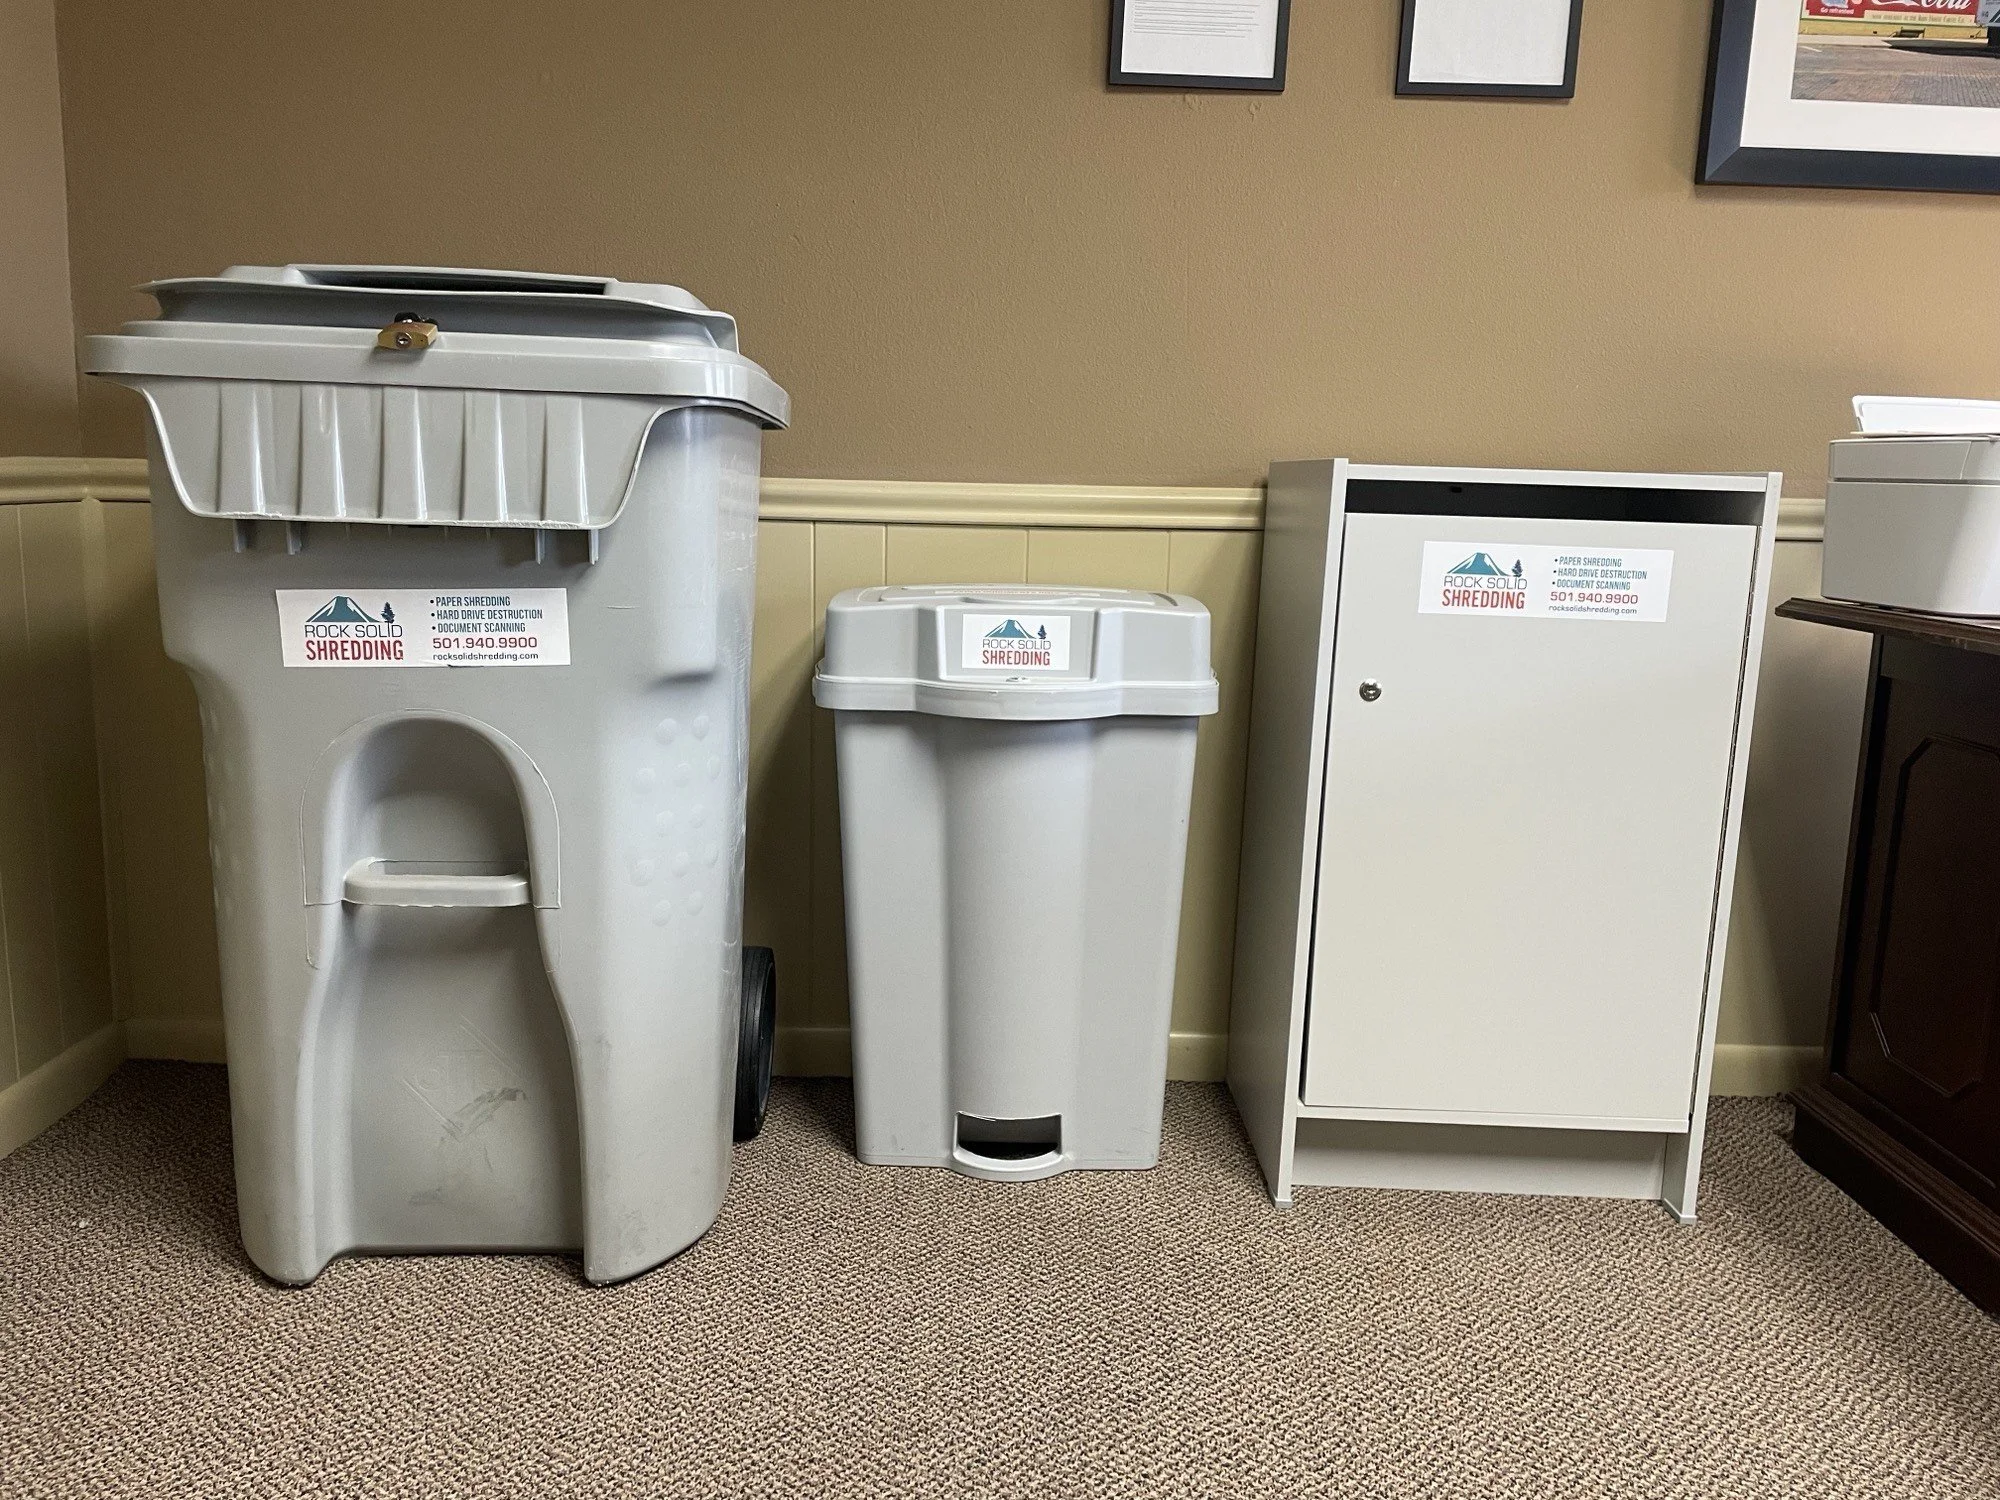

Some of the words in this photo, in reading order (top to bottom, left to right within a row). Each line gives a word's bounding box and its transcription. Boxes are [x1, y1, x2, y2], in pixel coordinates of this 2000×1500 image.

[1559, 556, 1582, 566] PAPER
[1583, 557, 1622, 568] SHREDDING
[1558, 568, 1577, 577] HARD
[1578, 568, 1599, 579] DRIVE
[1600, 569, 1648, 580] DESTRUCTION
[1443, 575, 1483, 589] ROCK
[1486, 577, 1528, 590] SOLID
[1556, 579, 1594, 589] DOCUMENT
[1595, 580, 1631, 591] SCANNING
[435, 596, 462, 607] PAPER
[463, 596, 511, 607] SHREDDING
[1442, 588, 1525, 609] SHREDDING
[1550, 591, 1639, 604] 501.940.9900
[436, 609, 460, 620] HARD
[461, 609, 486, 620] DRIVE
[487, 609, 543, 619] DESTRUCTION
[1548, 605, 1638, 616] rocksolidshredding.com
[304, 624, 351, 638] ROCK
[354, 624, 403, 638] SOLID
[437, 622, 482, 633] DOCUMENT
[484, 622, 526, 633] SCANNING
[432, 637, 538, 649] 501.940.9900
[982, 638, 1015, 649] ROCK
[1017, 639, 1052, 650] SOLID
[306, 639, 404, 661] SHREDDING
[432, 652, 539, 661] rocksolidshredding.com
[982, 649, 1051, 666] SHREDDING
